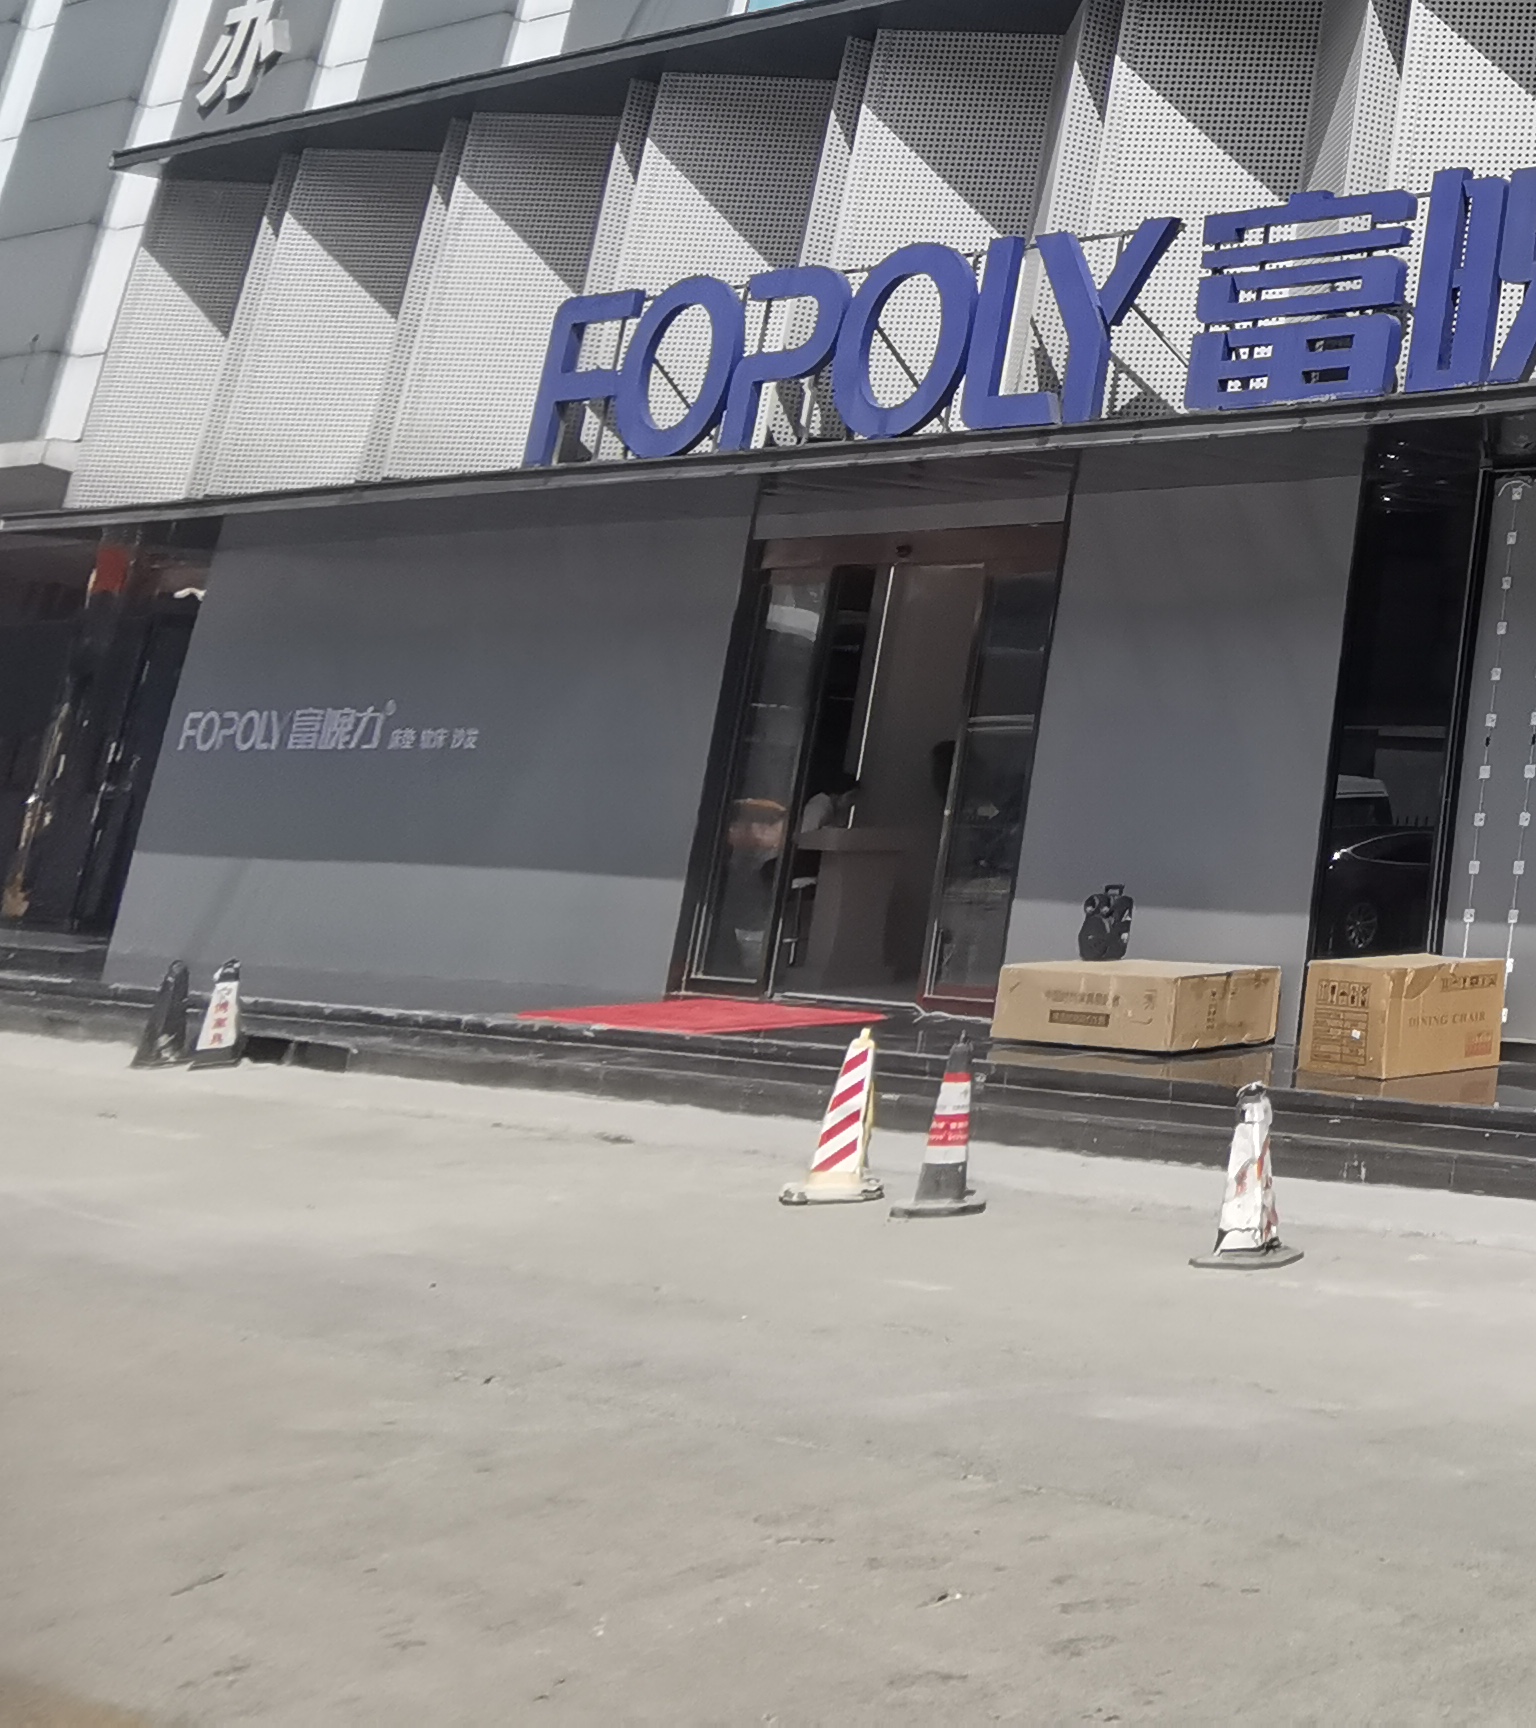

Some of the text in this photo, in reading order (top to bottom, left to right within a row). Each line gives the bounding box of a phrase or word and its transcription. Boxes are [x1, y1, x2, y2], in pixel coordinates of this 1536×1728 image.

[522, 217, 1184, 467] FOPOLY
[177, 710, 292, 751] FOPOLY
[1409, 1011, 1486, 1028] DINING CHAIR
